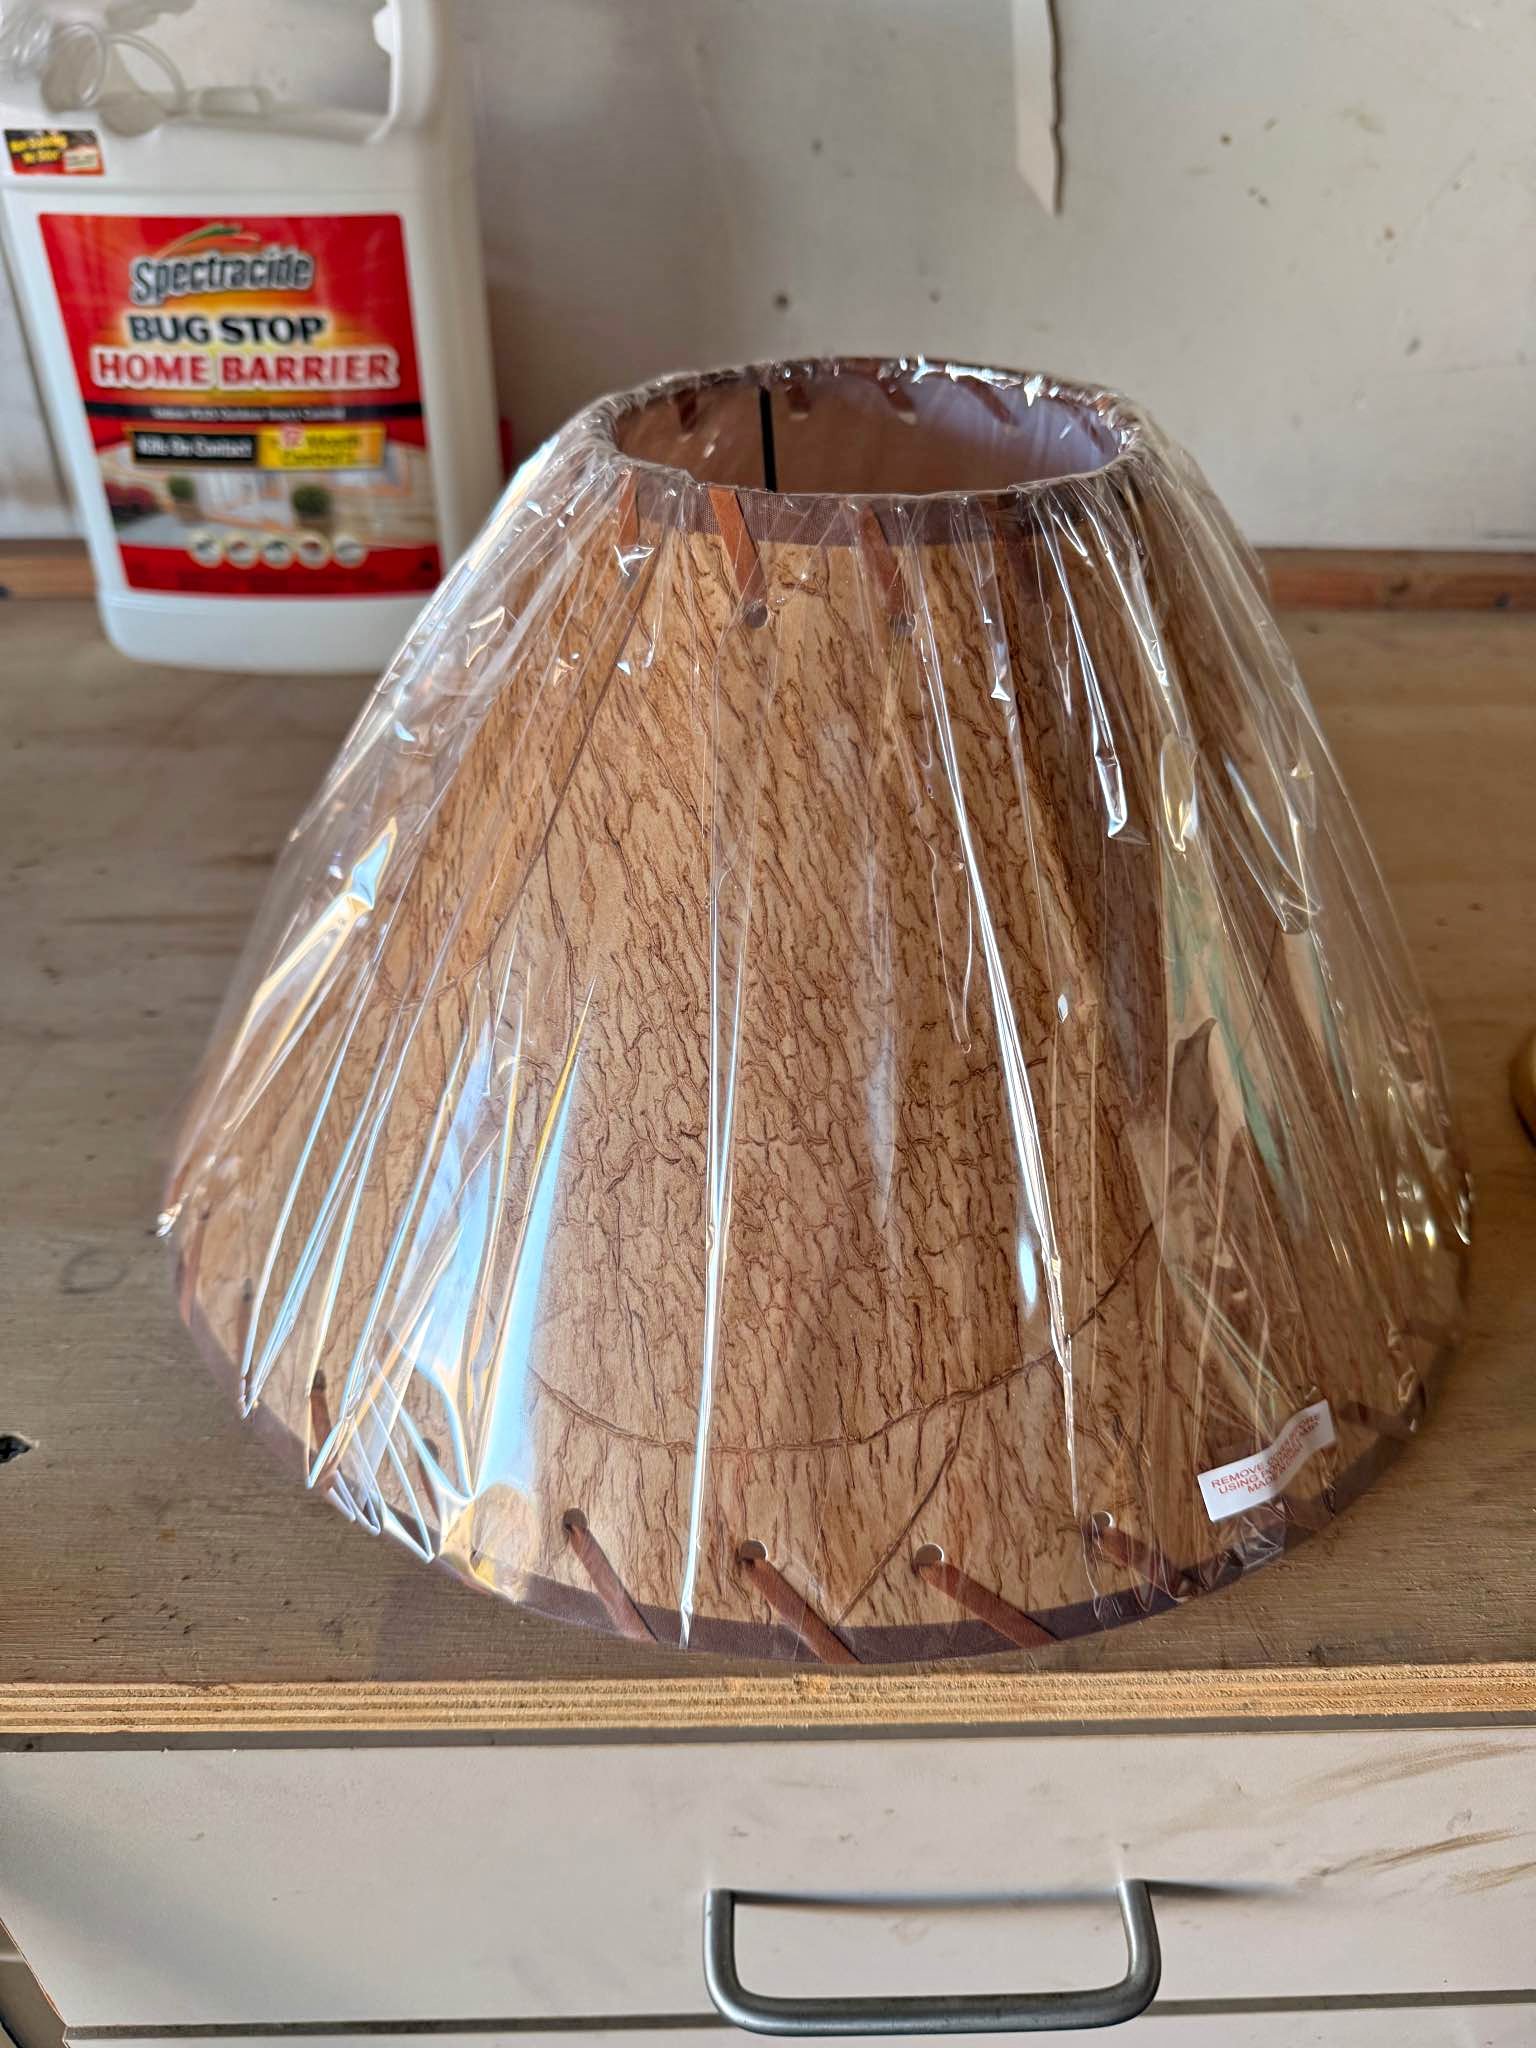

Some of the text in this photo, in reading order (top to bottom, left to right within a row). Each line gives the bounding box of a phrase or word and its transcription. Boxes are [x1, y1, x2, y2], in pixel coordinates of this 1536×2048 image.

[131, 248, 313, 304] Spectracide
[129, 315, 327, 345] BUG STOP
[96, 353, 391, 385] HOME BARRIER
[1210, 1462, 1265, 1489] REMOVE
[1217, 1473, 1259, 1495] USING
